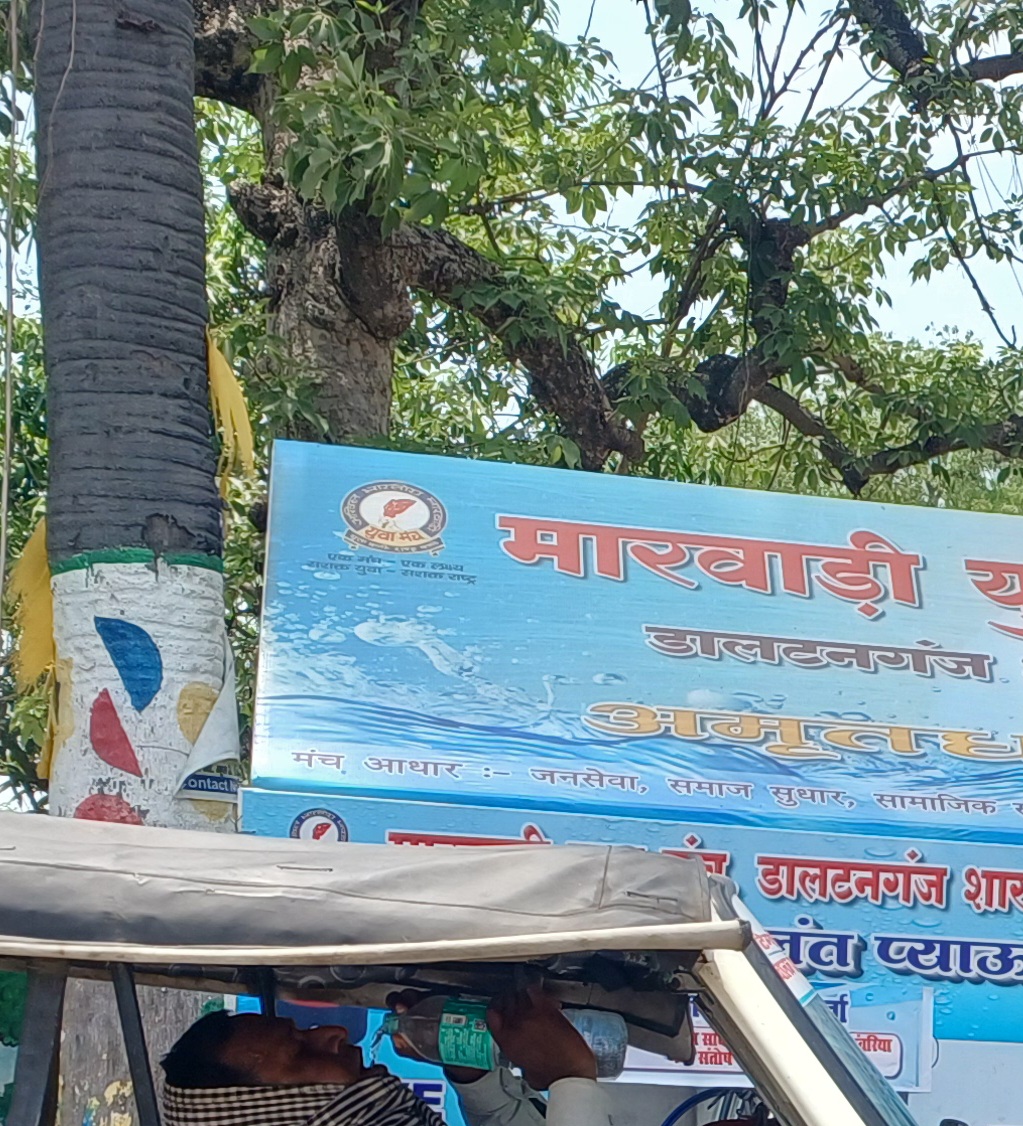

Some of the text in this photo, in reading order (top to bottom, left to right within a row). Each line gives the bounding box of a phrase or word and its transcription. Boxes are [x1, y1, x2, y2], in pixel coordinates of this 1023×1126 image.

[365, 525, 395, 542] युवा
[498, 515, 920, 618] मारवाड़ी
[644, 625, 992, 678] डालटनगंज
[182, 778, 228, 792] ontact
[292, 749, 345, 771] मंच
[364, 755, 462, 779] आधार
[530, 766, 648, 793] जनसेवा,
[668, 777, 752, 798] समाज
[770, 785, 856, 809] सुधार,
[874, 791, 997, 815] सामाजिक
[756, 849, 948, 906] डालटनगंज
